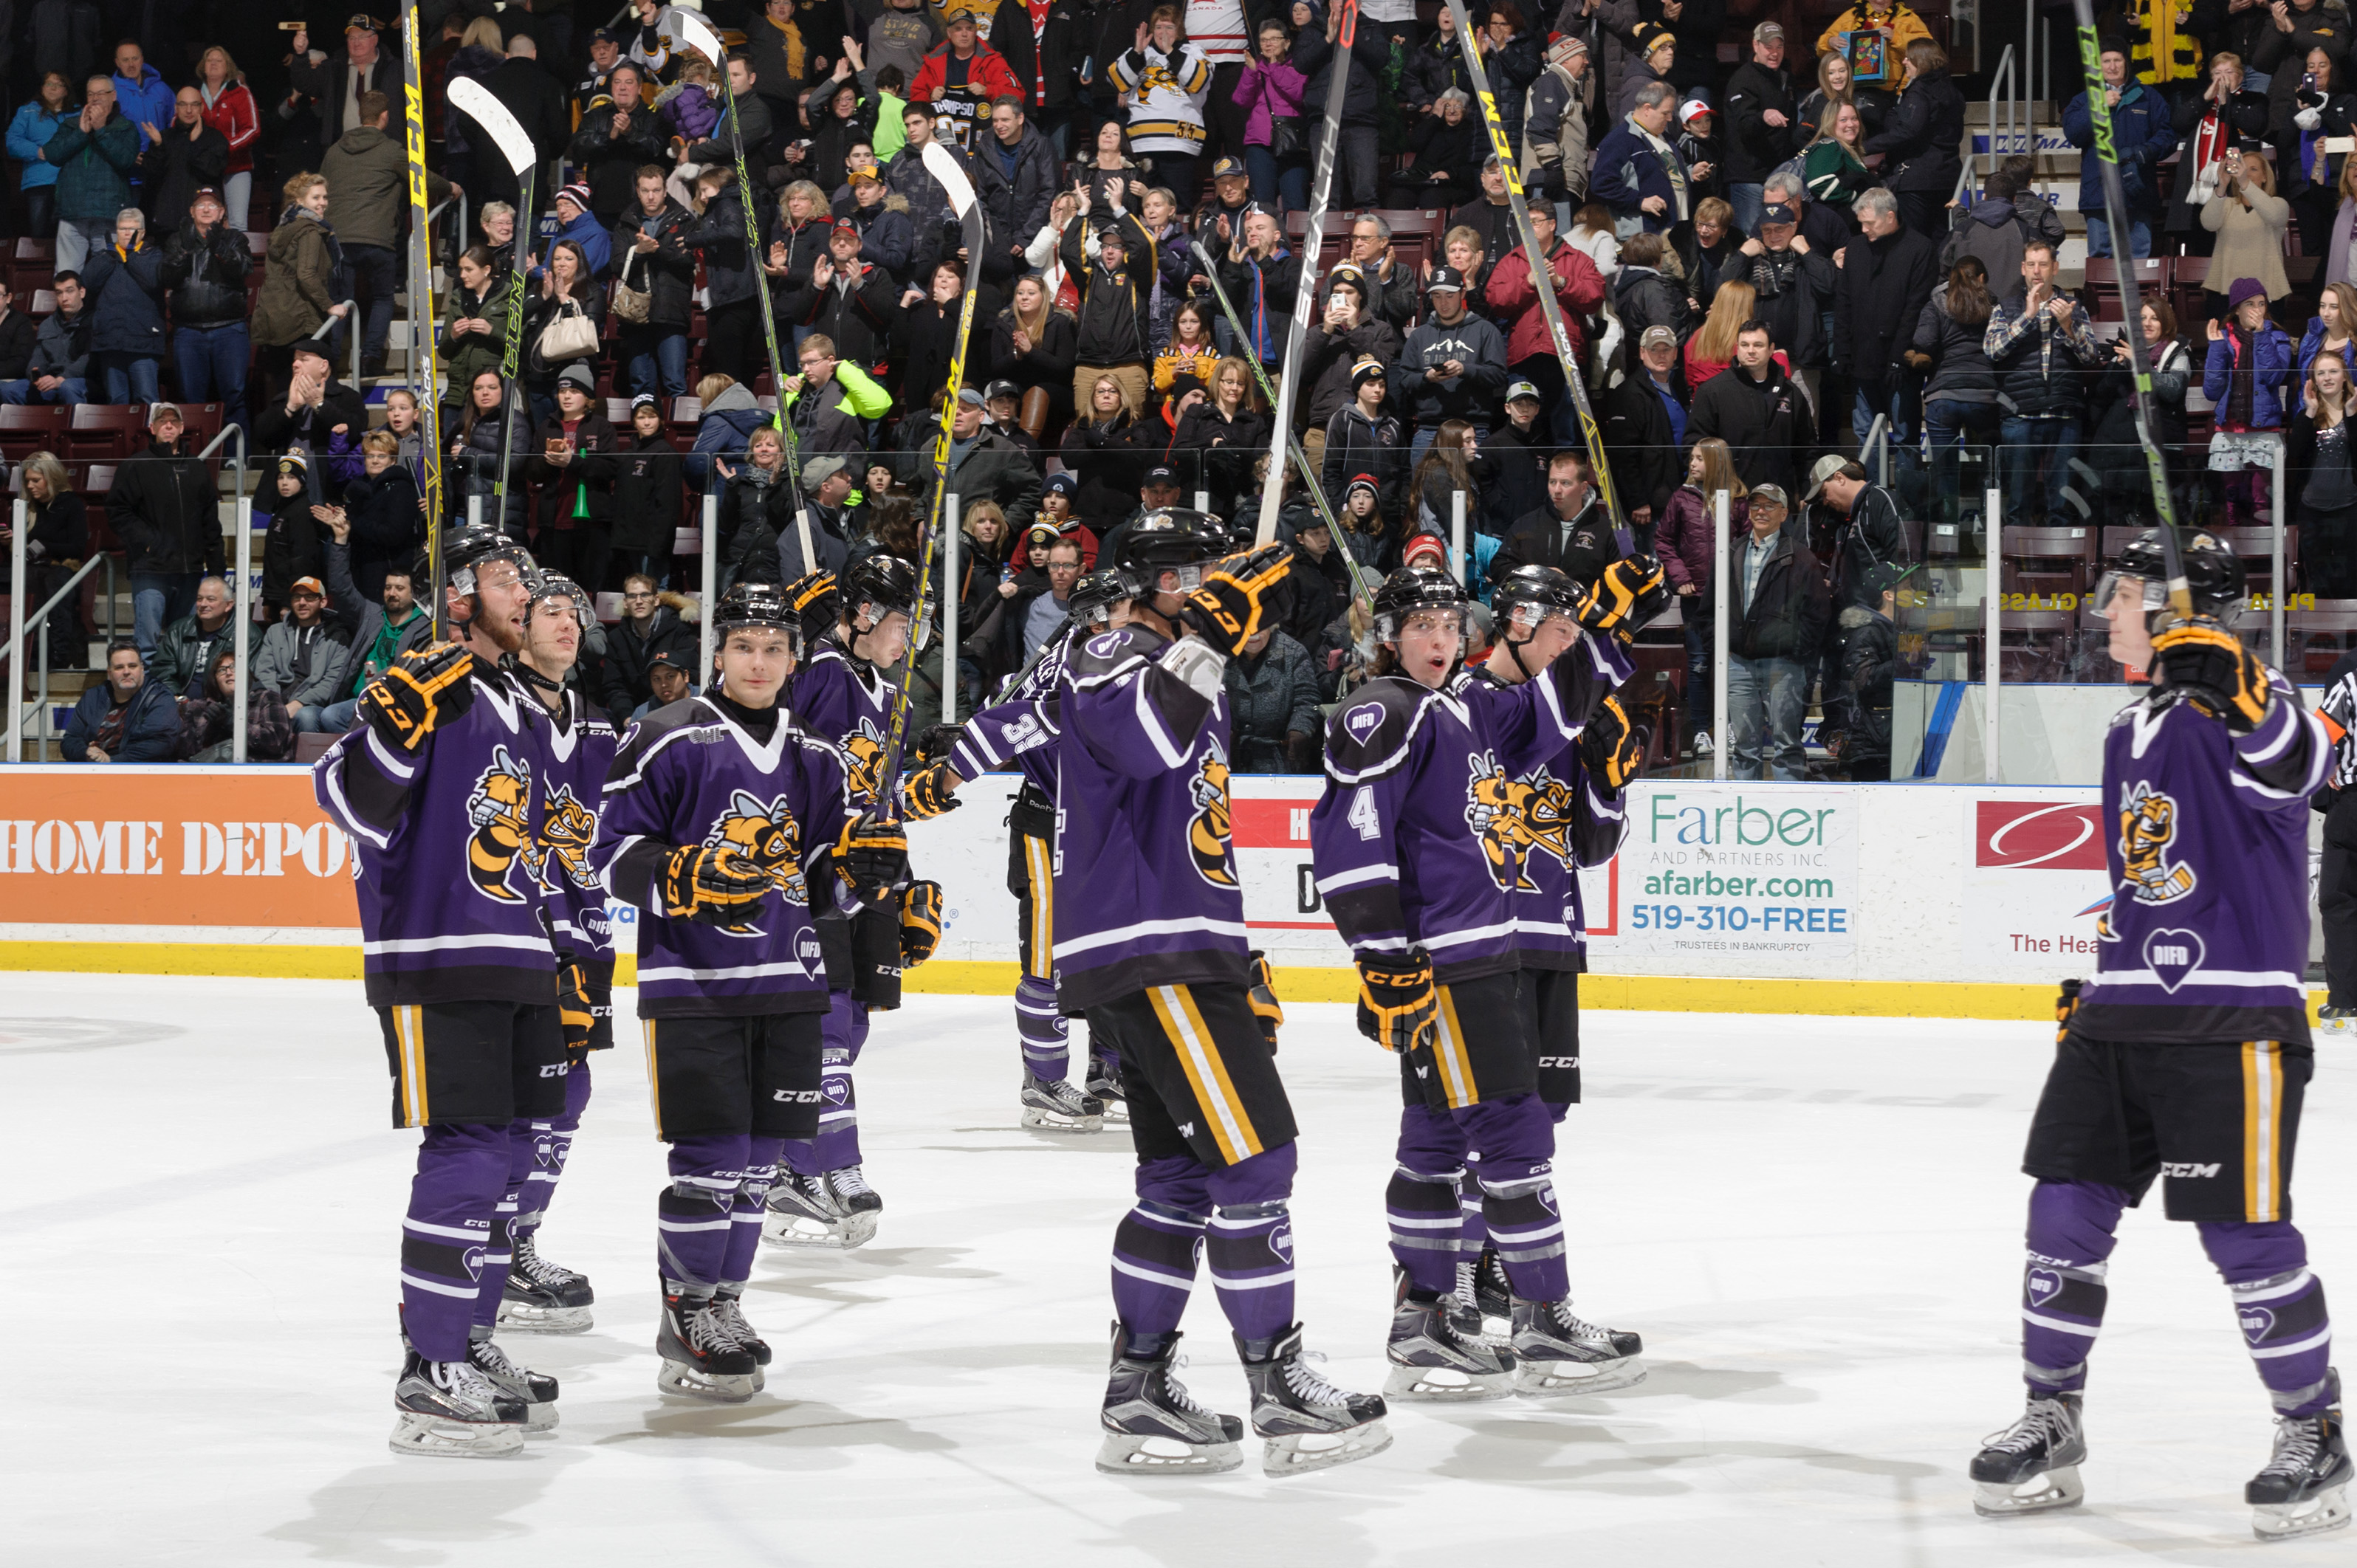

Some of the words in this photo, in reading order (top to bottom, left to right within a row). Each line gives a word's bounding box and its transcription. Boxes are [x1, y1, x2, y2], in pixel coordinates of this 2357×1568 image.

[1176, 120, 1195, 140] 55
[405, 83, 426, 210] CCM
[1479, 90, 1523, 196] CCM
[1996, 137, 2076, 150] WINMA
[1295, 114, 1339, 329] STEALTH
[503, 267, 526, 379] CCM
[422, 354, 435, 415] TACKS
[427, 411, 436, 449] ULTRA
[749, 602, 778, 611] CCM
[1352, 713, 1375, 729] DIFD
[1029, 799, 1056, 814] Reebo
[1348, 785, 1381, 842] 4
[1651, 794, 1836, 847] Farber
[0, 820, 162, 875] HOME
[180, 822, 348, 877] DEPO
[1650, 851, 1687, 864] AND
[1697, 852, 1785, 867] PARTNERS
[1794, 853, 1828, 867] INC.
[667, 844, 697, 907] CCM
[1644, 869, 1834, 898] afarber.com
[1631, 905, 1847, 933] 519-310-FREE
[800, 941, 820, 958] DIFD
[1674, 941, 1726, 950] TRUSTEES
[1729, 942, 1740, 950] IN
[1743, 942, 1811, 952] BANKRUPTCY
[2009, 934, 2051, 952] The
[2153, 946, 2189, 966] DIFD
[876, 964, 901, 977] CC
[1365, 966, 1433, 987] CCM
[590, 1005, 612, 1017] CC
[568, 1039, 589, 1049] CCM
[539, 1061, 568, 1078] CC
[827, 1084, 844, 1096] DIFD
[2031, 1276, 2052, 1293] DIFD
